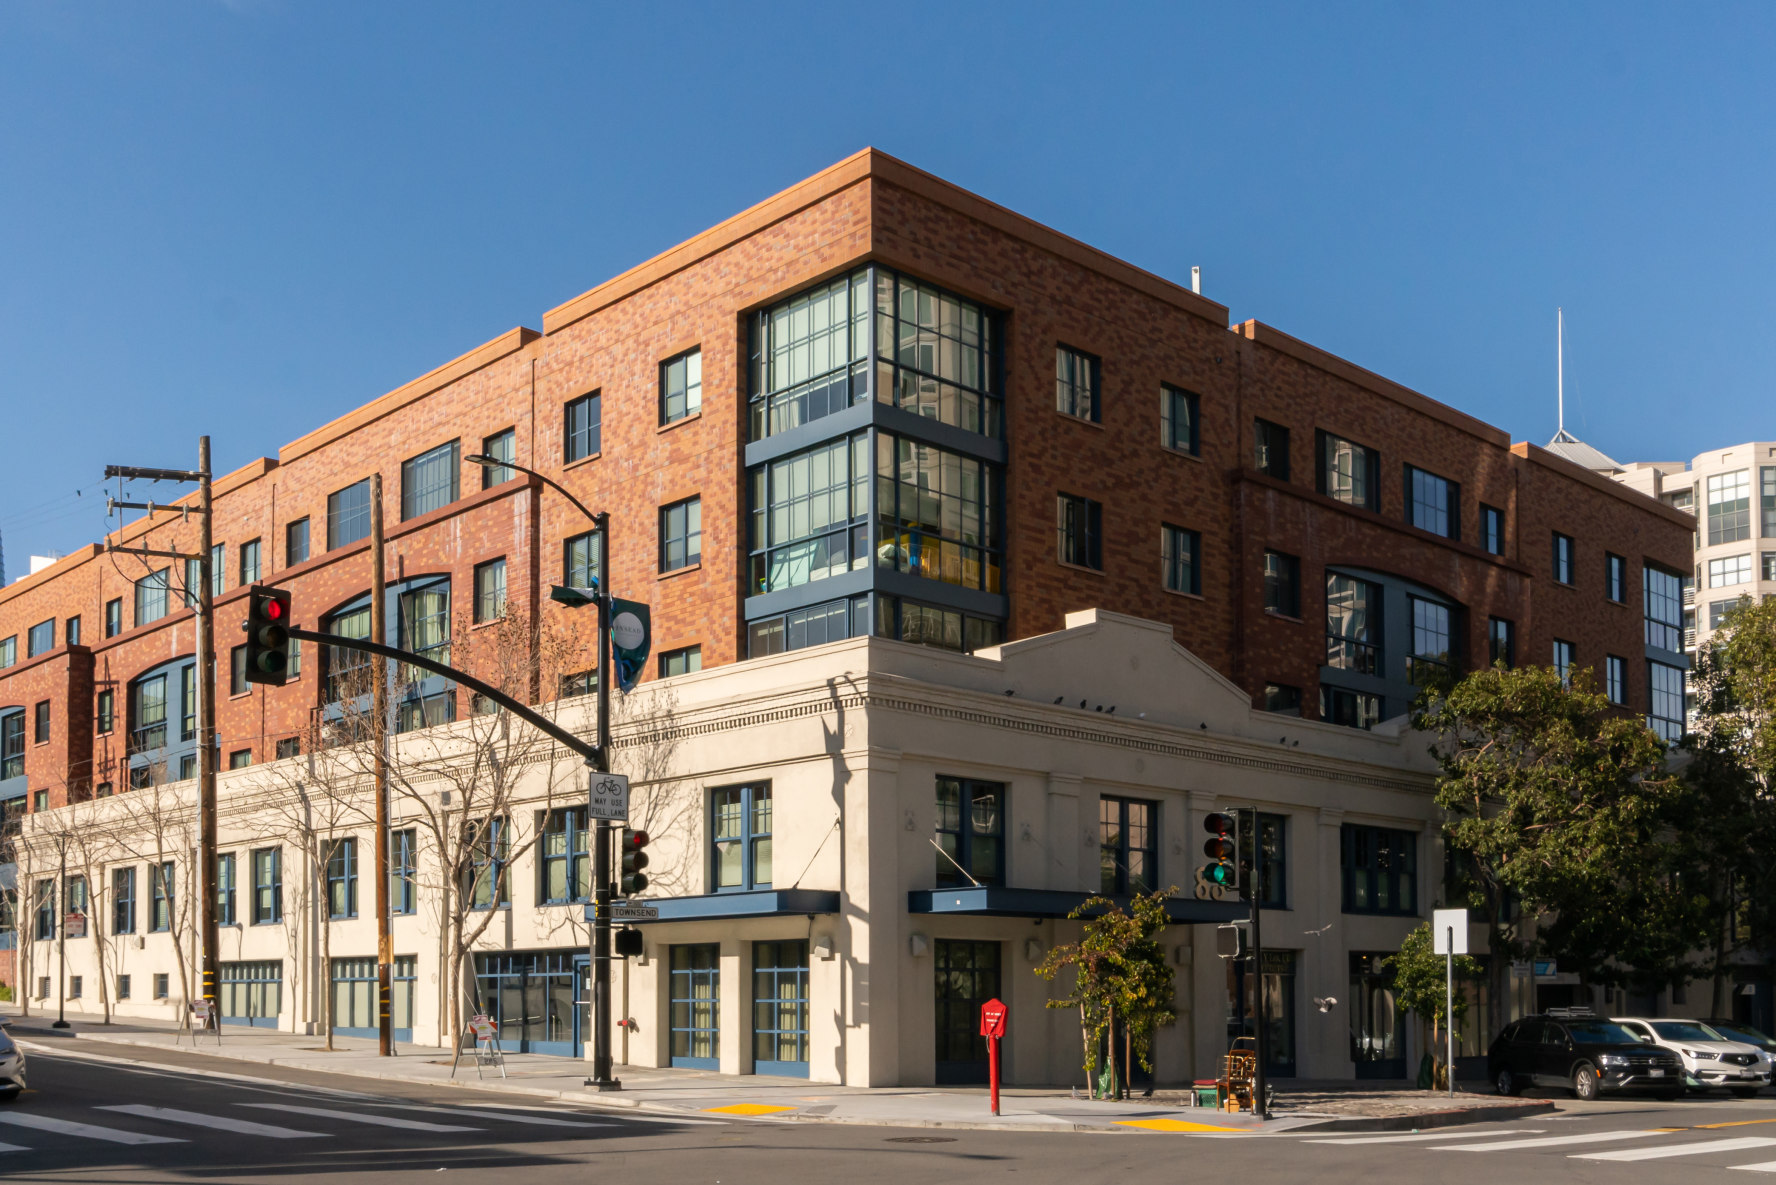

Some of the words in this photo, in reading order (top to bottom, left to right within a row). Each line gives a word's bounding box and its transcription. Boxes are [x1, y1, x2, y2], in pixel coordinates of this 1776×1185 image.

[594, 797, 606, 805] MAY
[611, 799, 622, 807] USE
[592, 807, 606, 815] FULL
[611, 809, 625, 817] LANE
[614, 908, 657, 917] TOWNSEND
